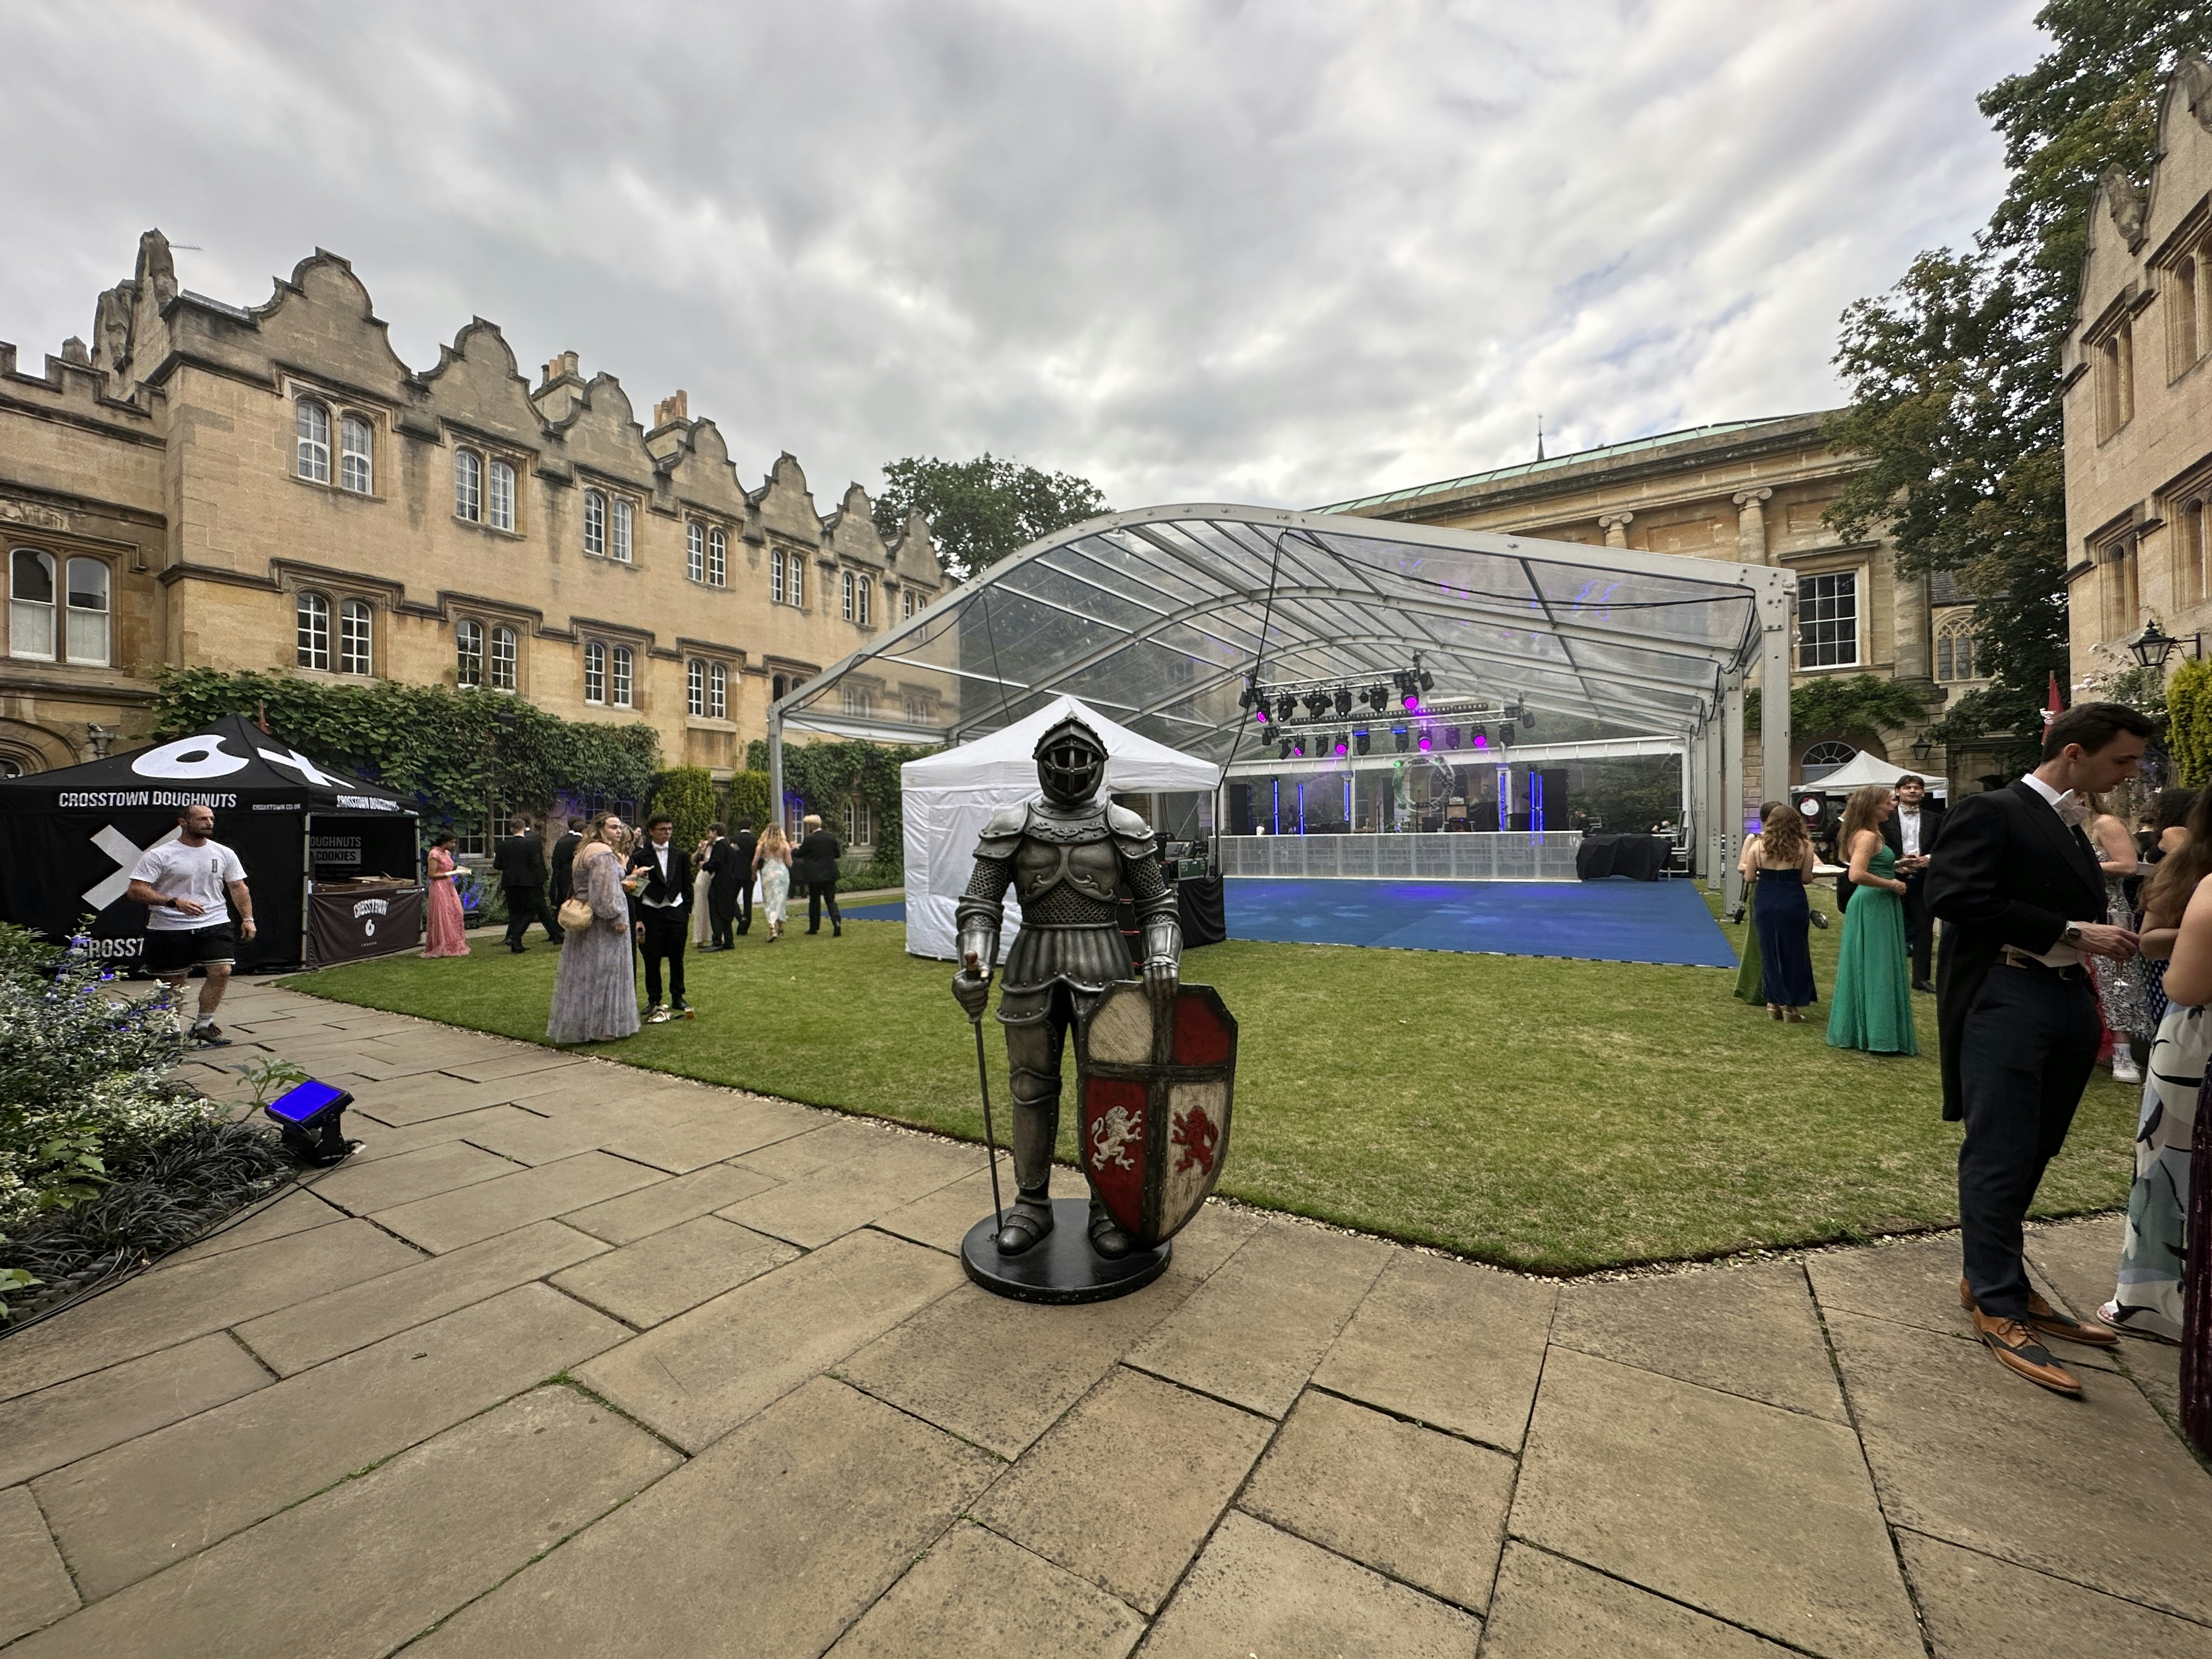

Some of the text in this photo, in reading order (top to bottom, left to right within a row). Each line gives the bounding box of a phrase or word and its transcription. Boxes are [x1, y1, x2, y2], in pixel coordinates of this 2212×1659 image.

[59, 791, 237, 808] CROSSTOWN DOUGHNUTS
[316, 851, 356, 861] COOKIES
